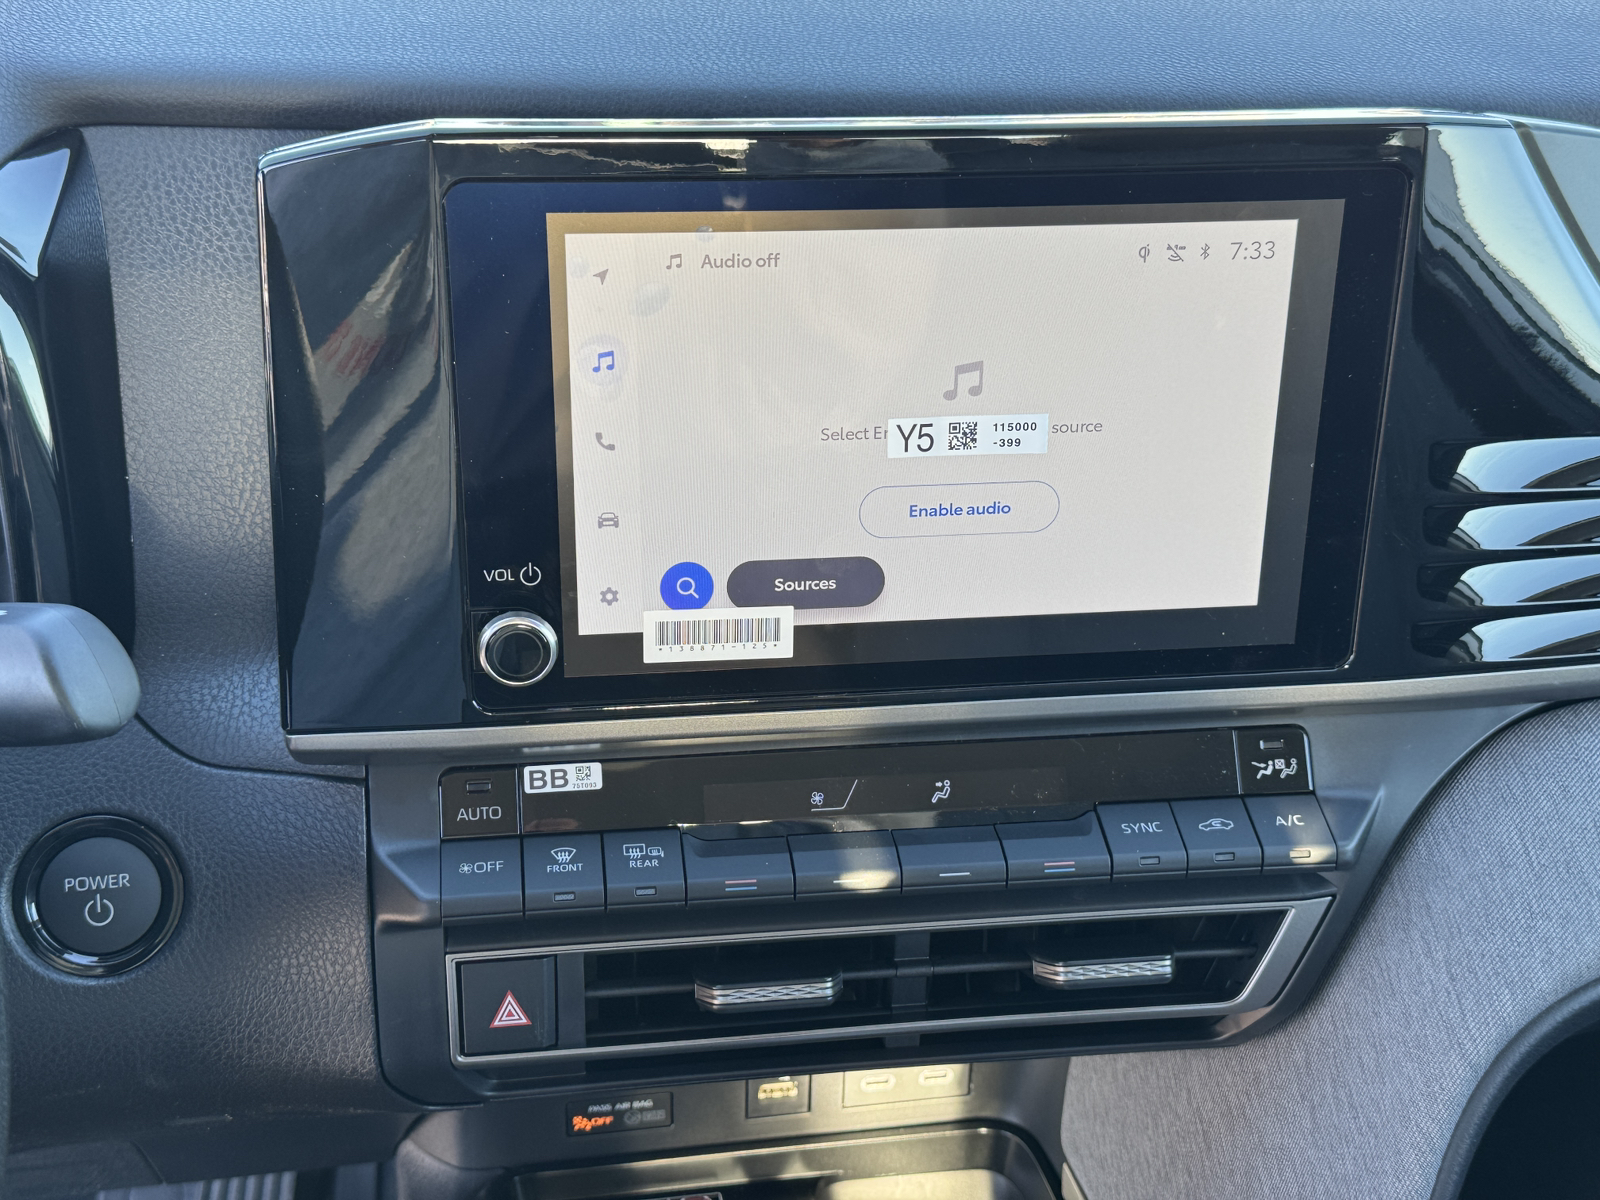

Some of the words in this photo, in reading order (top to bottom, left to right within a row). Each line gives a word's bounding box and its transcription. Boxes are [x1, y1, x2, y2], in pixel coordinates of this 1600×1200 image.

[1230, 240, 1276, 260] 7:33
[700, 253, 752, 269] Audio
[755, 252, 781, 268] off
[820, 427, 870, 441] Select
[1051, 422, 1103, 434] source
[992, 421, 1037, 432] 115000
[896, 423, 934, 453] Y5
[992, 438, 1022, 448] -399
[908, 502, 963, 518] Enable
[966, 501, 1011, 516] audio
[483, 568, 515, 582] VOL
[774, 578, 837, 592] Sources
[528, 768, 569, 790] BB
[456, 806, 502, 822] AUTO
[1275, 814, 1305, 827] A/C
[1121, 822, 1163, 834] SYNC
[474, 861, 504, 873] OFF
[546, 863, 584, 873] FRONT
[629, 859, 659, 868] REAR
[64, 873, 131, 892] POWER
